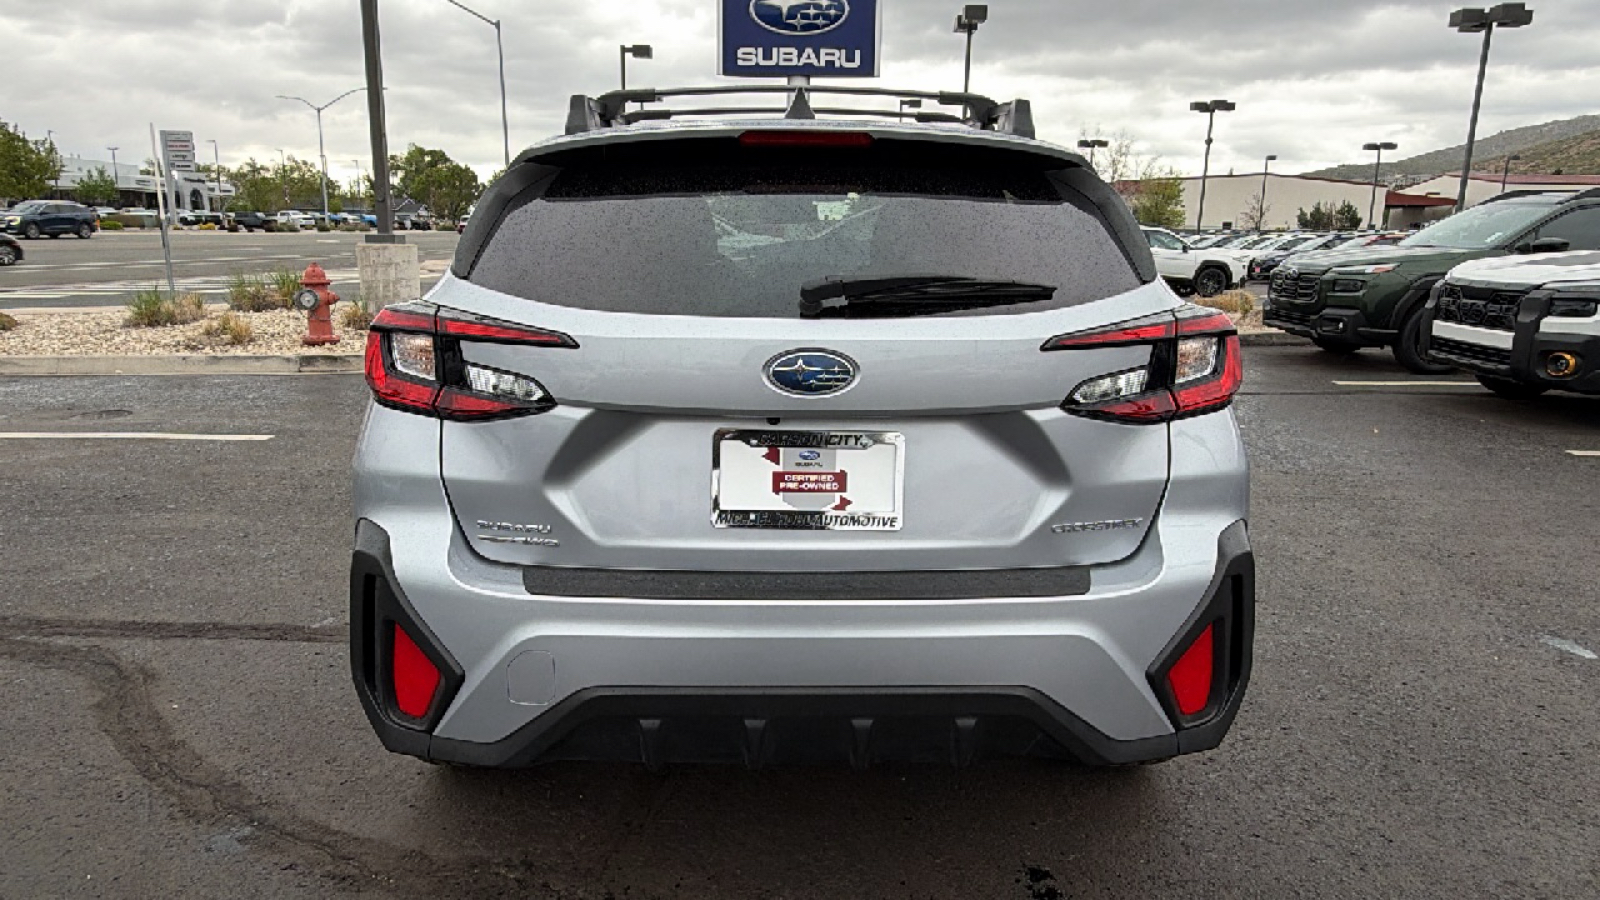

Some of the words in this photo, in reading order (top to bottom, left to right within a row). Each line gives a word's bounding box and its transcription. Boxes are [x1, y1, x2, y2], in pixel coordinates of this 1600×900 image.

[736, 47, 861, 69] SUBARU
[825, 434, 863, 446] CITY
[784, 474, 835, 482] CERTIFIED
[779, 482, 840, 490] PRE-OWNED
[811, 514, 898, 528] AUTOMOTIVE
